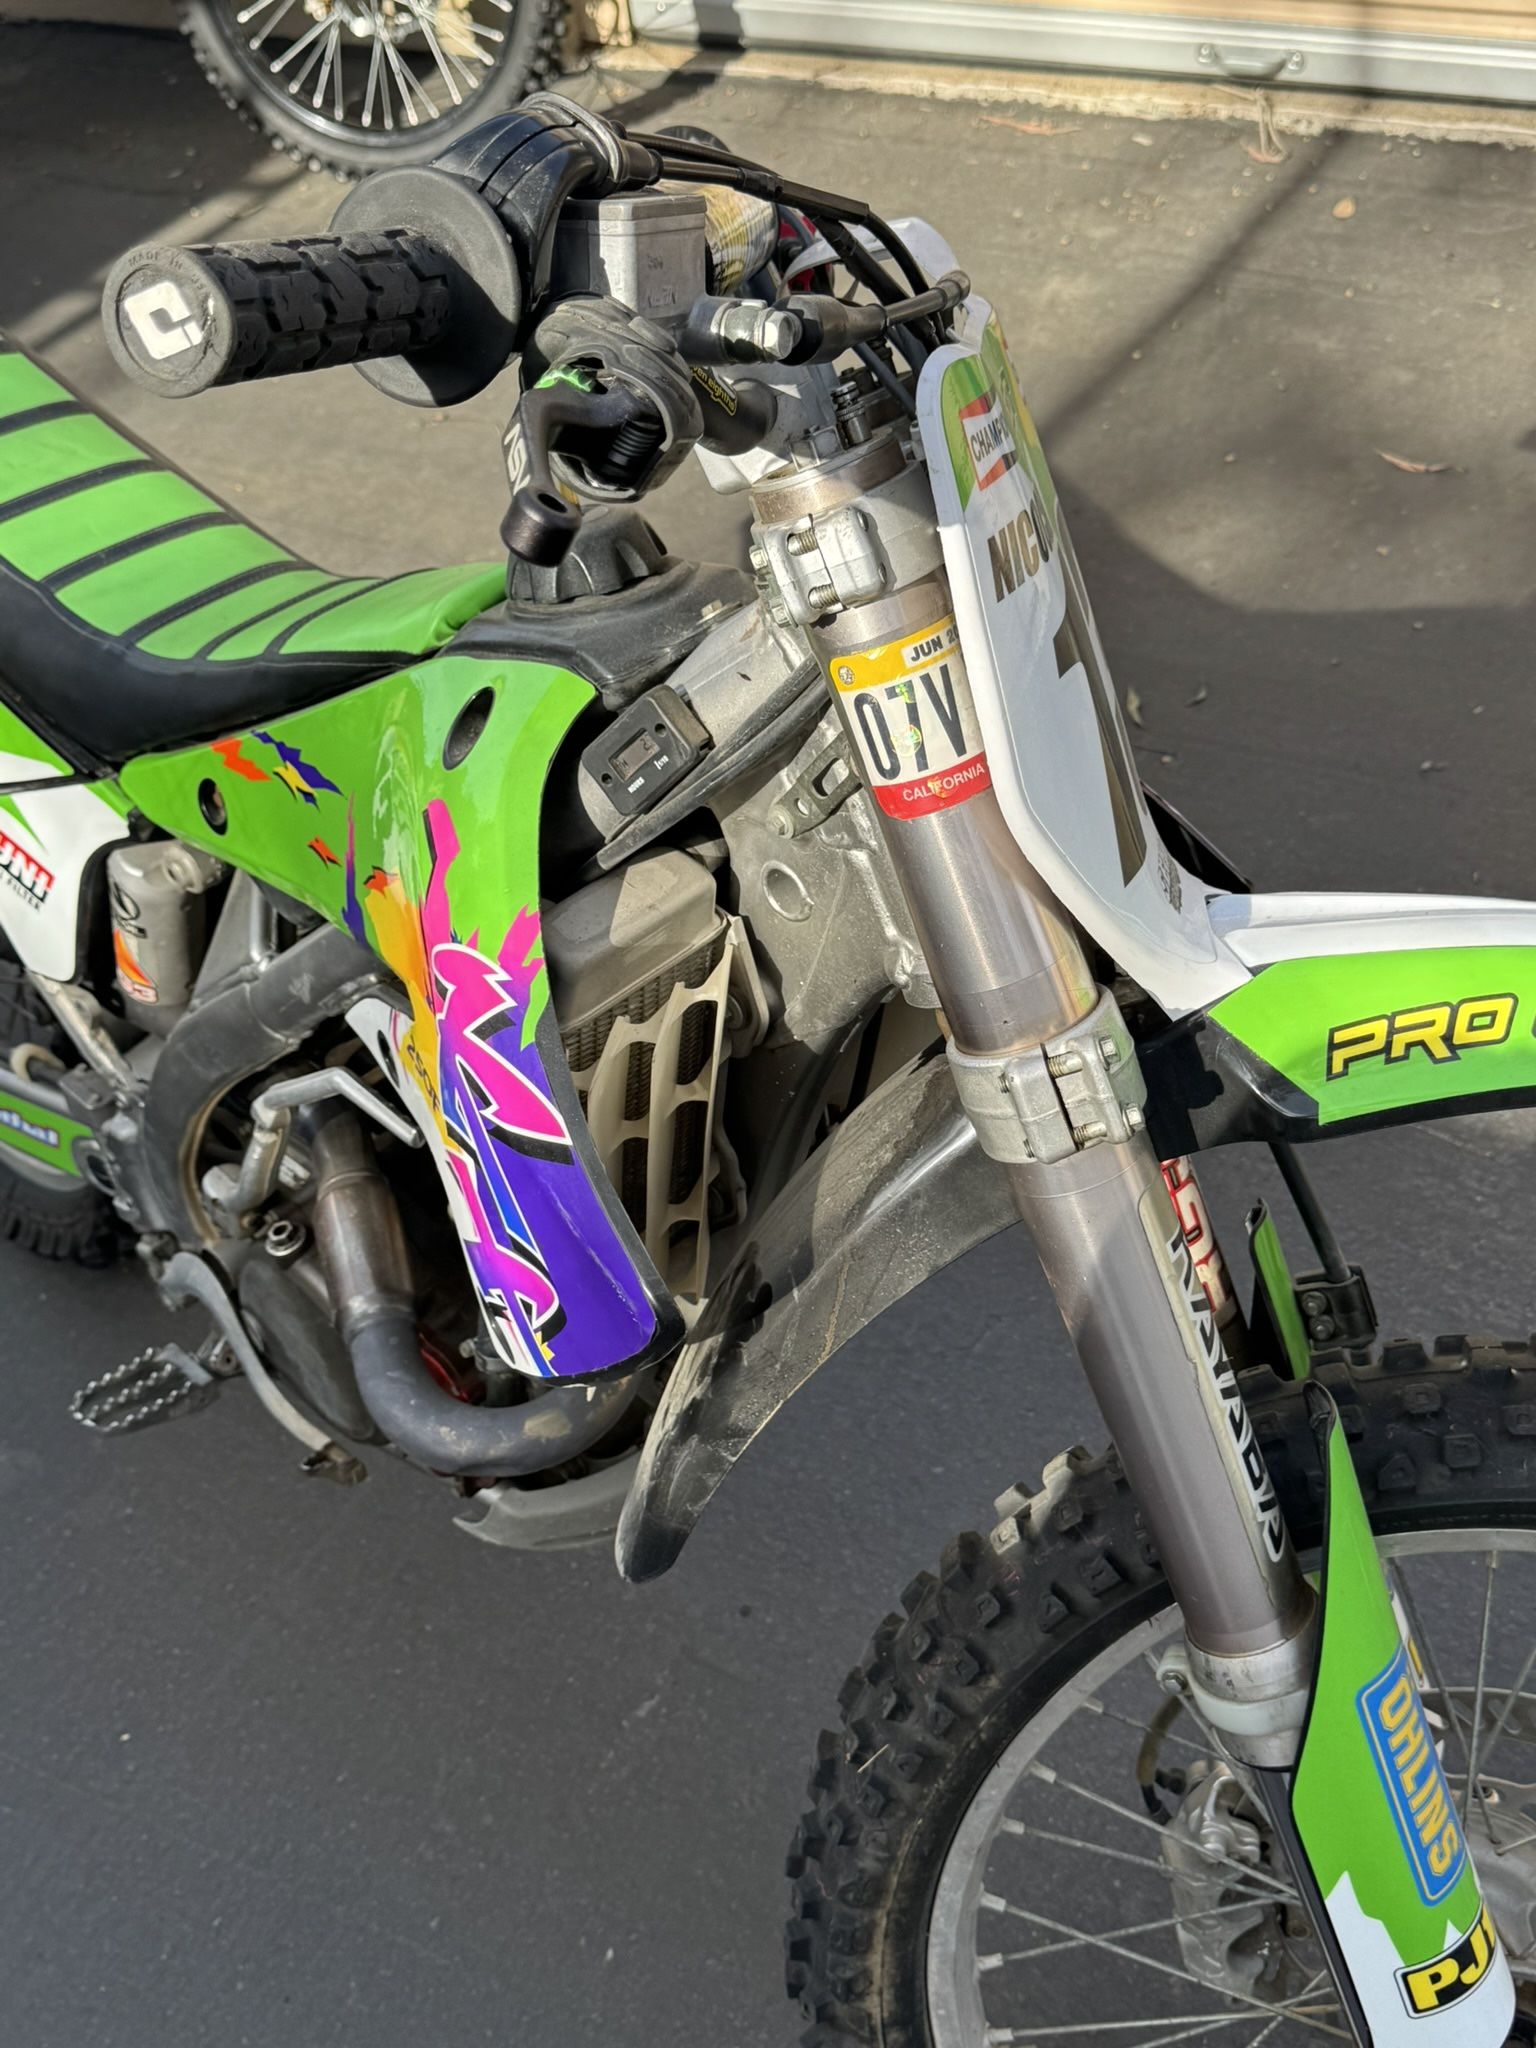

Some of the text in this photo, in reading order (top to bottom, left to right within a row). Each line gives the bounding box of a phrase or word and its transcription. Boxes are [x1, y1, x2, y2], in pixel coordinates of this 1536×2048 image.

[911, 635, 943, 662] JUN
[854, 663, 967, 780] 07V
[902, 763, 985, 801] CALIFORNIA
[1326, 993, 1519, 1081] PRO
